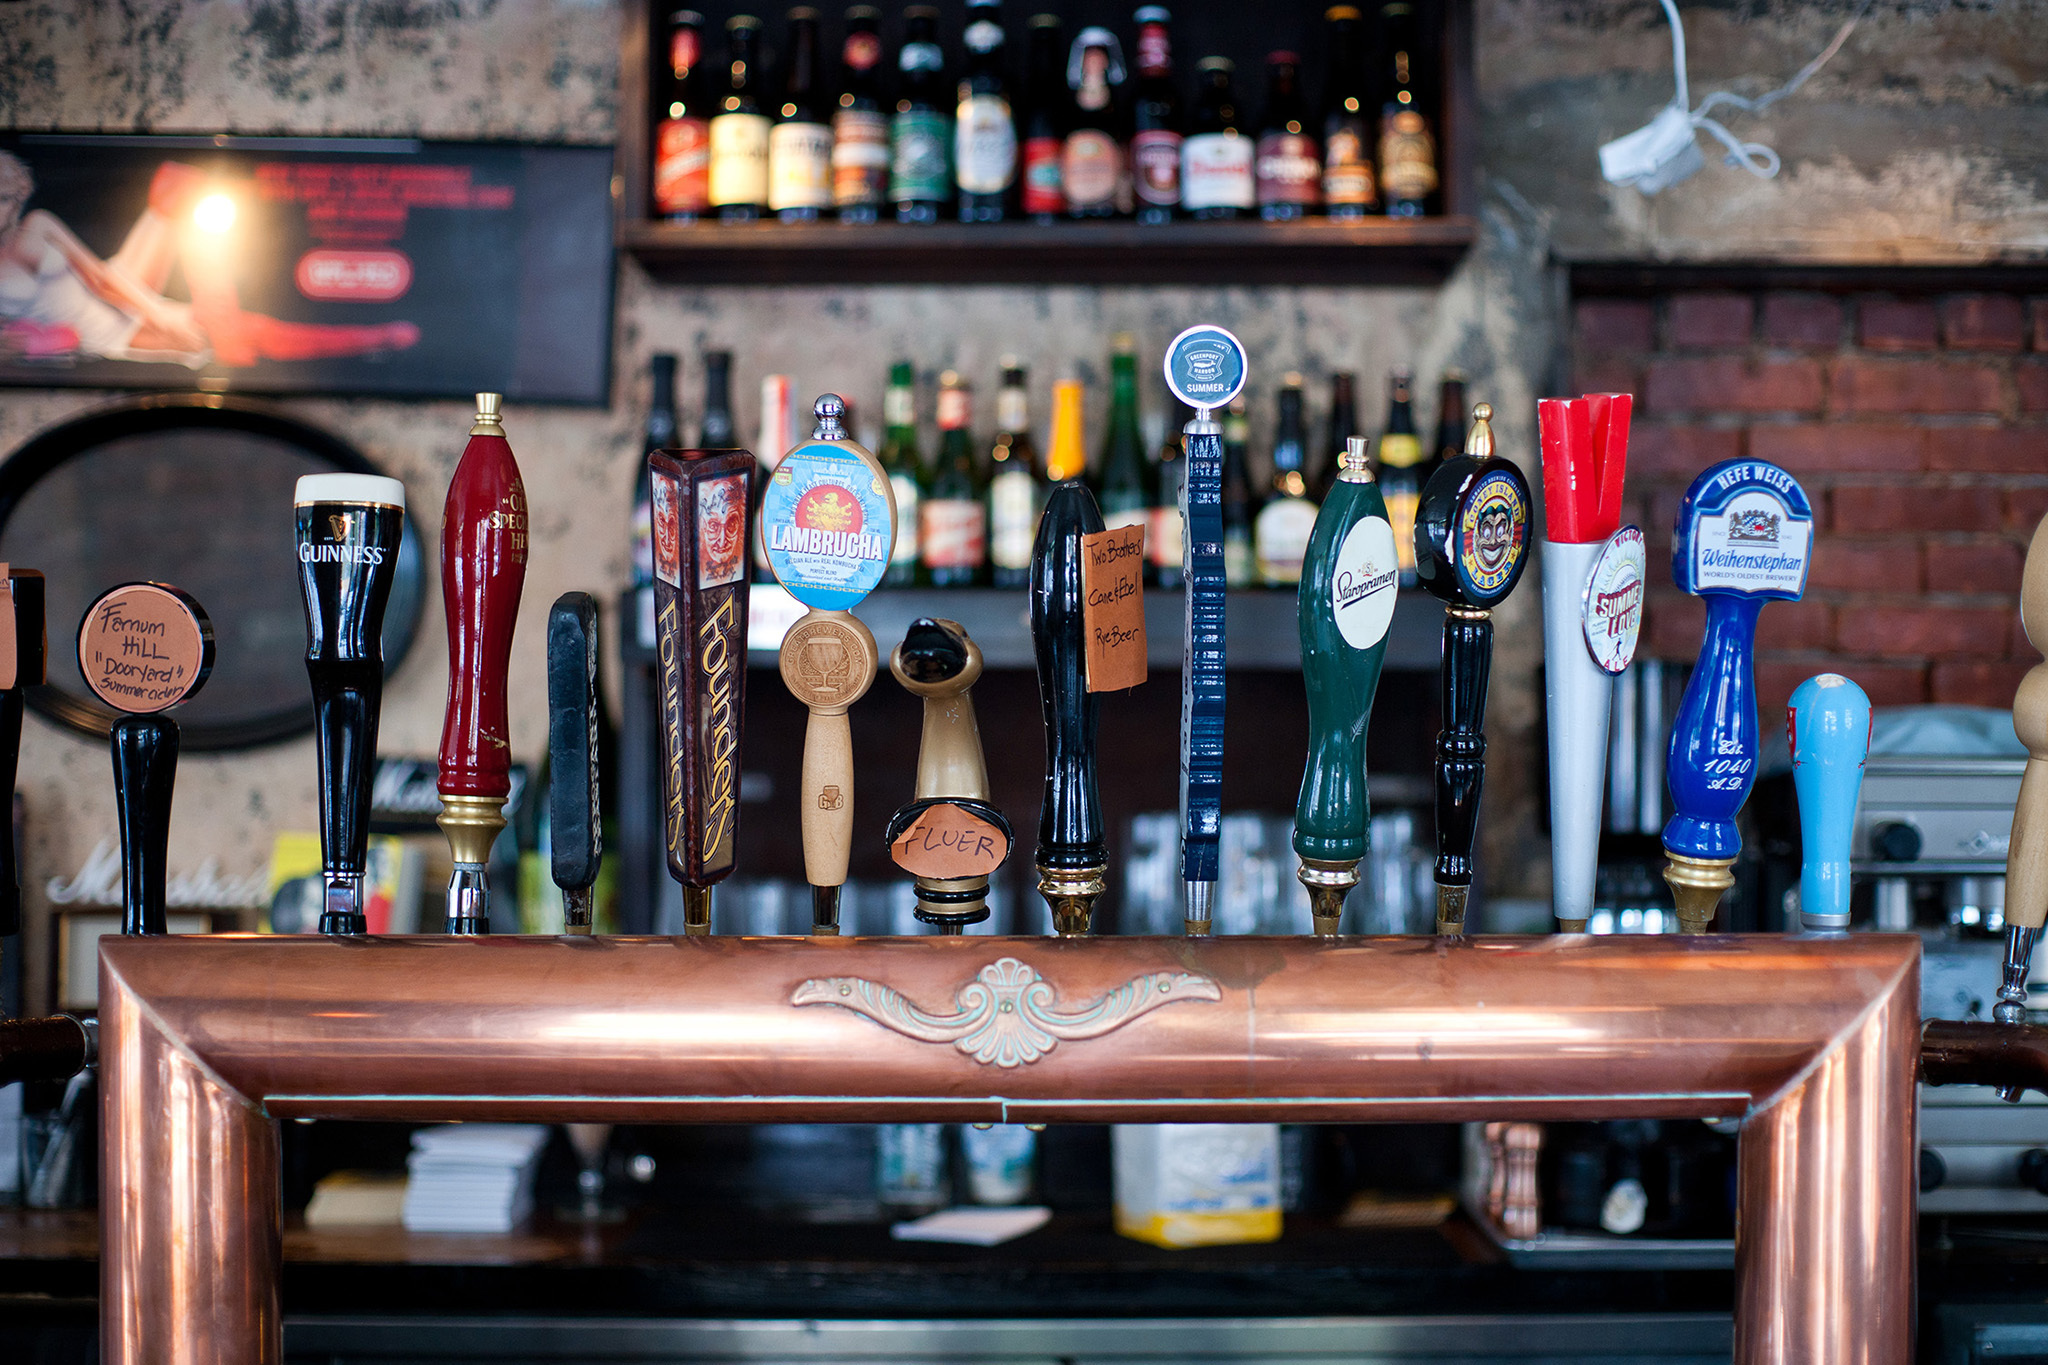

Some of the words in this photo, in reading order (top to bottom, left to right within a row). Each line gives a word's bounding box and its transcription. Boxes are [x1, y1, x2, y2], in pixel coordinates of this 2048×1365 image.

[1187, 383, 1224, 393] SUMMER
[1717, 466, 1750, 490] HEFE
[1754, 466, 1794, 493] WEISS
[1470, 486, 1492, 523] CONEY
[1496, 484, 1519, 516] ISLAND
[771, 525, 883, 561] LAMBRUCHA
[1615, 529, 1642, 548] VICTORY
[299, 542, 383, 565] GUINNESS
[1086, 542, 1106, 566] Two
[1702, 548, 1802, 573] Weihenstephan
[1471, 561, 1512, 587] LAGER
[1704, 571, 1735, 579] WORLD'S
[1737, 572, 1764, 580] OLDEST
[1765, 573, 1797, 582] BREWERY
[1336, 569, 1396, 603] Staropramen
[1608, 606, 1637, 639] LOVE
[1110, 625, 1139, 648] Beer
[1604, 655, 1629, 672] ALE
[699, 587, 739, 864] Founders
[1717, 739, 1744, 755] Est.
[1704, 758, 1752, 774] 1040
[1707, 776, 1744, 790] A.D.
